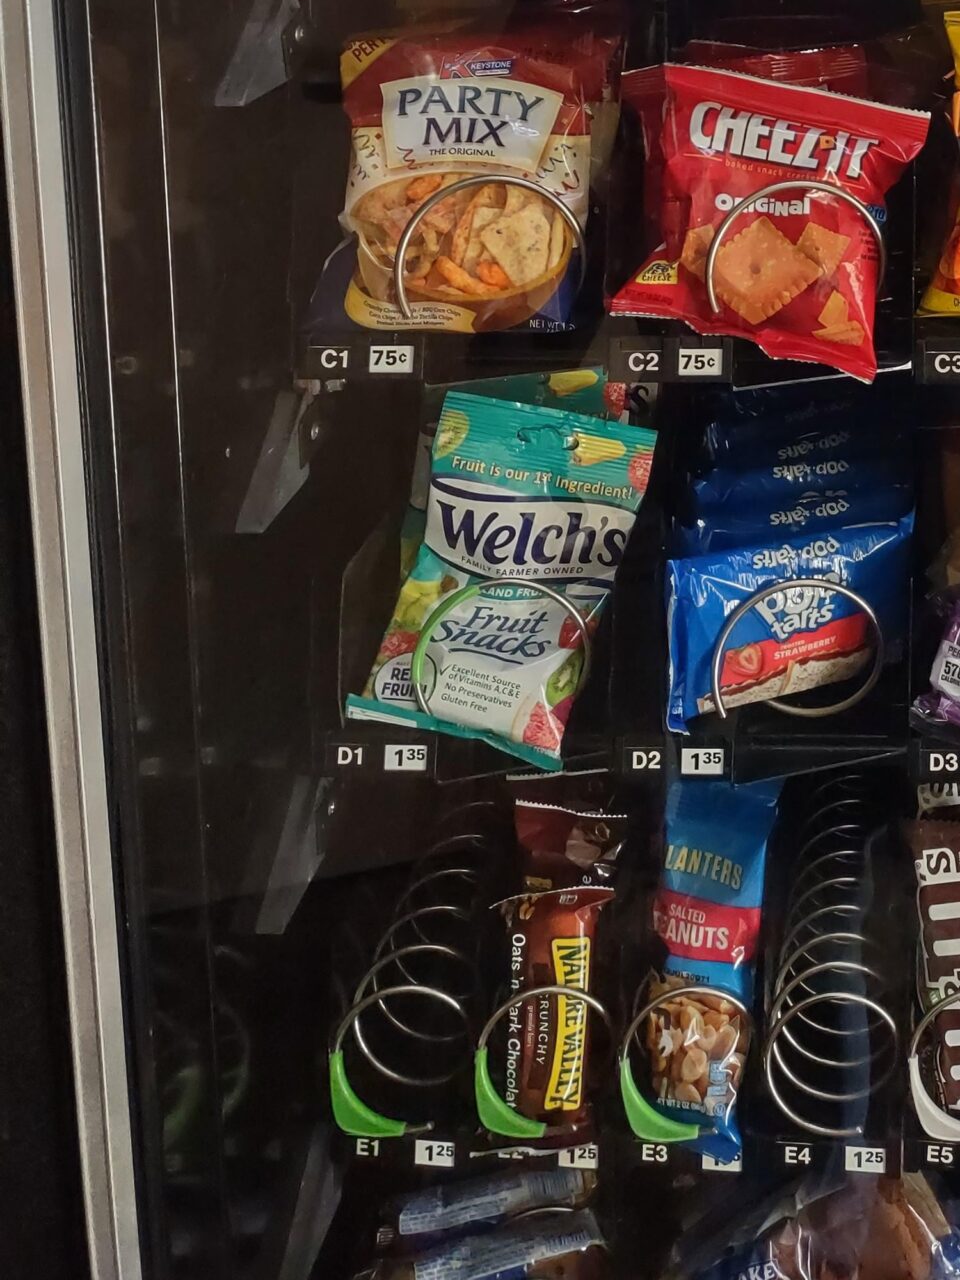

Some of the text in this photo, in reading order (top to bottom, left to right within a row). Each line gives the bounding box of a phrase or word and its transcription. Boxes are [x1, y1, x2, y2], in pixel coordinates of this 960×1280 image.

[470, 60, 512, 70] KEYSTONE
[397, 85, 544, 122] PARTY
[422, 117, 511, 147] MIX
[429, 147, 496, 158] THE ORIGINAL
[725, 158, 753, 172] baked
[320, 348, 349, 368] C1
[372, 350, 407, 367] 75¢
[628, 353, 660, 372] C2
[681, 355, 716, 371] 75¢
[452, 455, 634, 501] Fruit is our Ingredient!
[436, 498, 630, 567] Welch's
[461, 555, 584, 577] FAMILY FARMER OWNED
[463, 605, 549, 634] Fruit
[430, 620, 552, 657] Snacks
[774, 635, 837, 660] STRAWBERRY
[448, 672, 492, 691] of Vitamins
[452, 664, 521, 689] Excellent Source
[441, 693, 488, 713] Gluten Free
[444, 682, 512, 708] No Preservatives
[337, 747, 363, 765] D1
[394, 749, 426, 768] 135
[632, 751, 661, 769] D2
[690, 752, 721, 770] 135
[929, 753, 959, 772] D3
[664, 844, 743, 890] LANTERS
[669, 903, 706, 924] SALTED
[511, 933, 526, 971] Oats
[550, 1029, 585, 1106] VALLEY
[356, 1139, 379, 1156] E1
[424, 1144, 454, 1162] 125
[566, 1147, 597, 1164] 125
[642, 1144, 668, 1162] E3
[785, 1147, 811, 1164] E4
[927, 1147, 953, 1164] E5
[853, 1151, 884, 1168] 125
